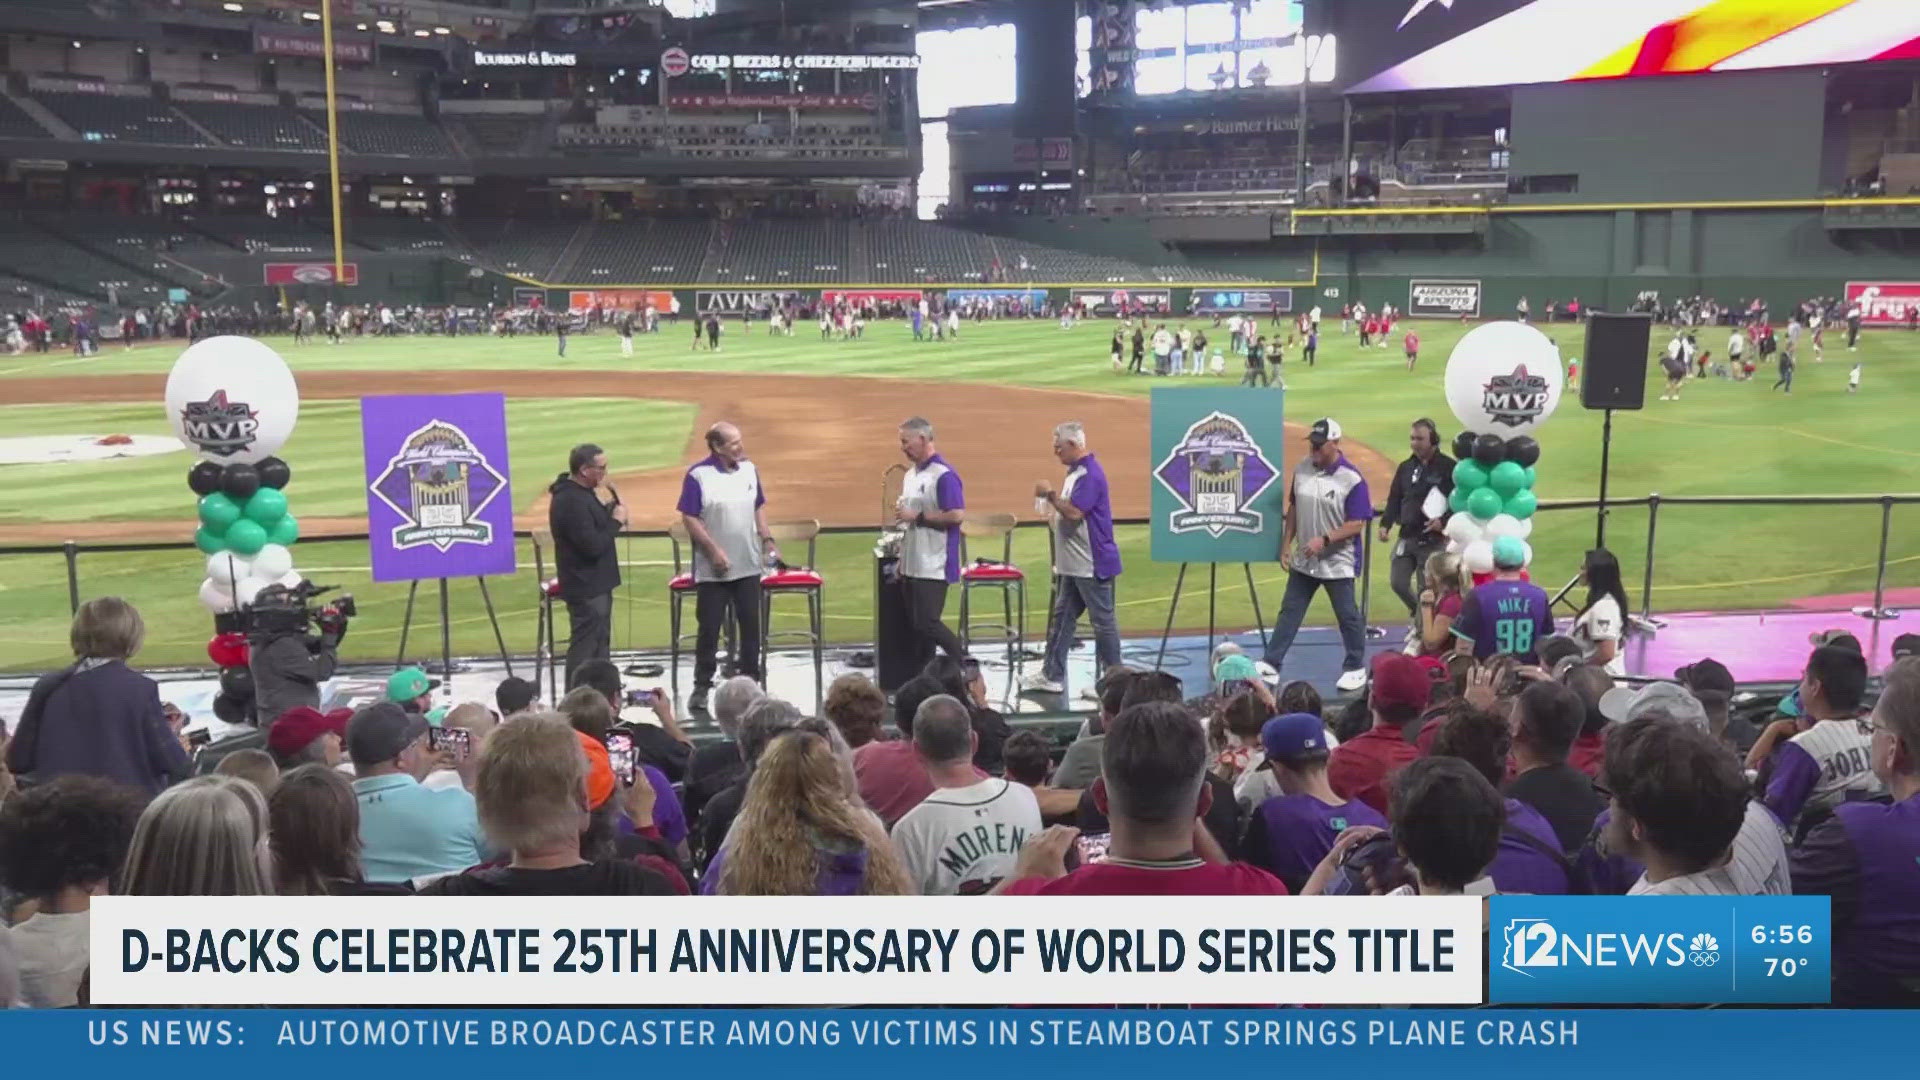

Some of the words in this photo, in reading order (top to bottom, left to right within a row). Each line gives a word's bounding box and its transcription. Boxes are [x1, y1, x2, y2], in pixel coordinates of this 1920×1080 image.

[691, 55, 731, 69] COLD
[733, 55, 782, 69] BEERS
[783, 56, 791, 69] &
[794, 55, 921, 69] CHEESEBURGERS
[1212, 120, 1262, 135] Banner
[1323, 287, 1340, 299] 413
[1418, 287, 1469, 296] ARIZONA
[1485, 392, 1549, 410] MVP
[184, 418, 258, 441] MVP
[1498, 598, 1531, 615] MIKE
[1496, 619, 1534, 654] 98
[939, 823, 1028, 877] MOREN
